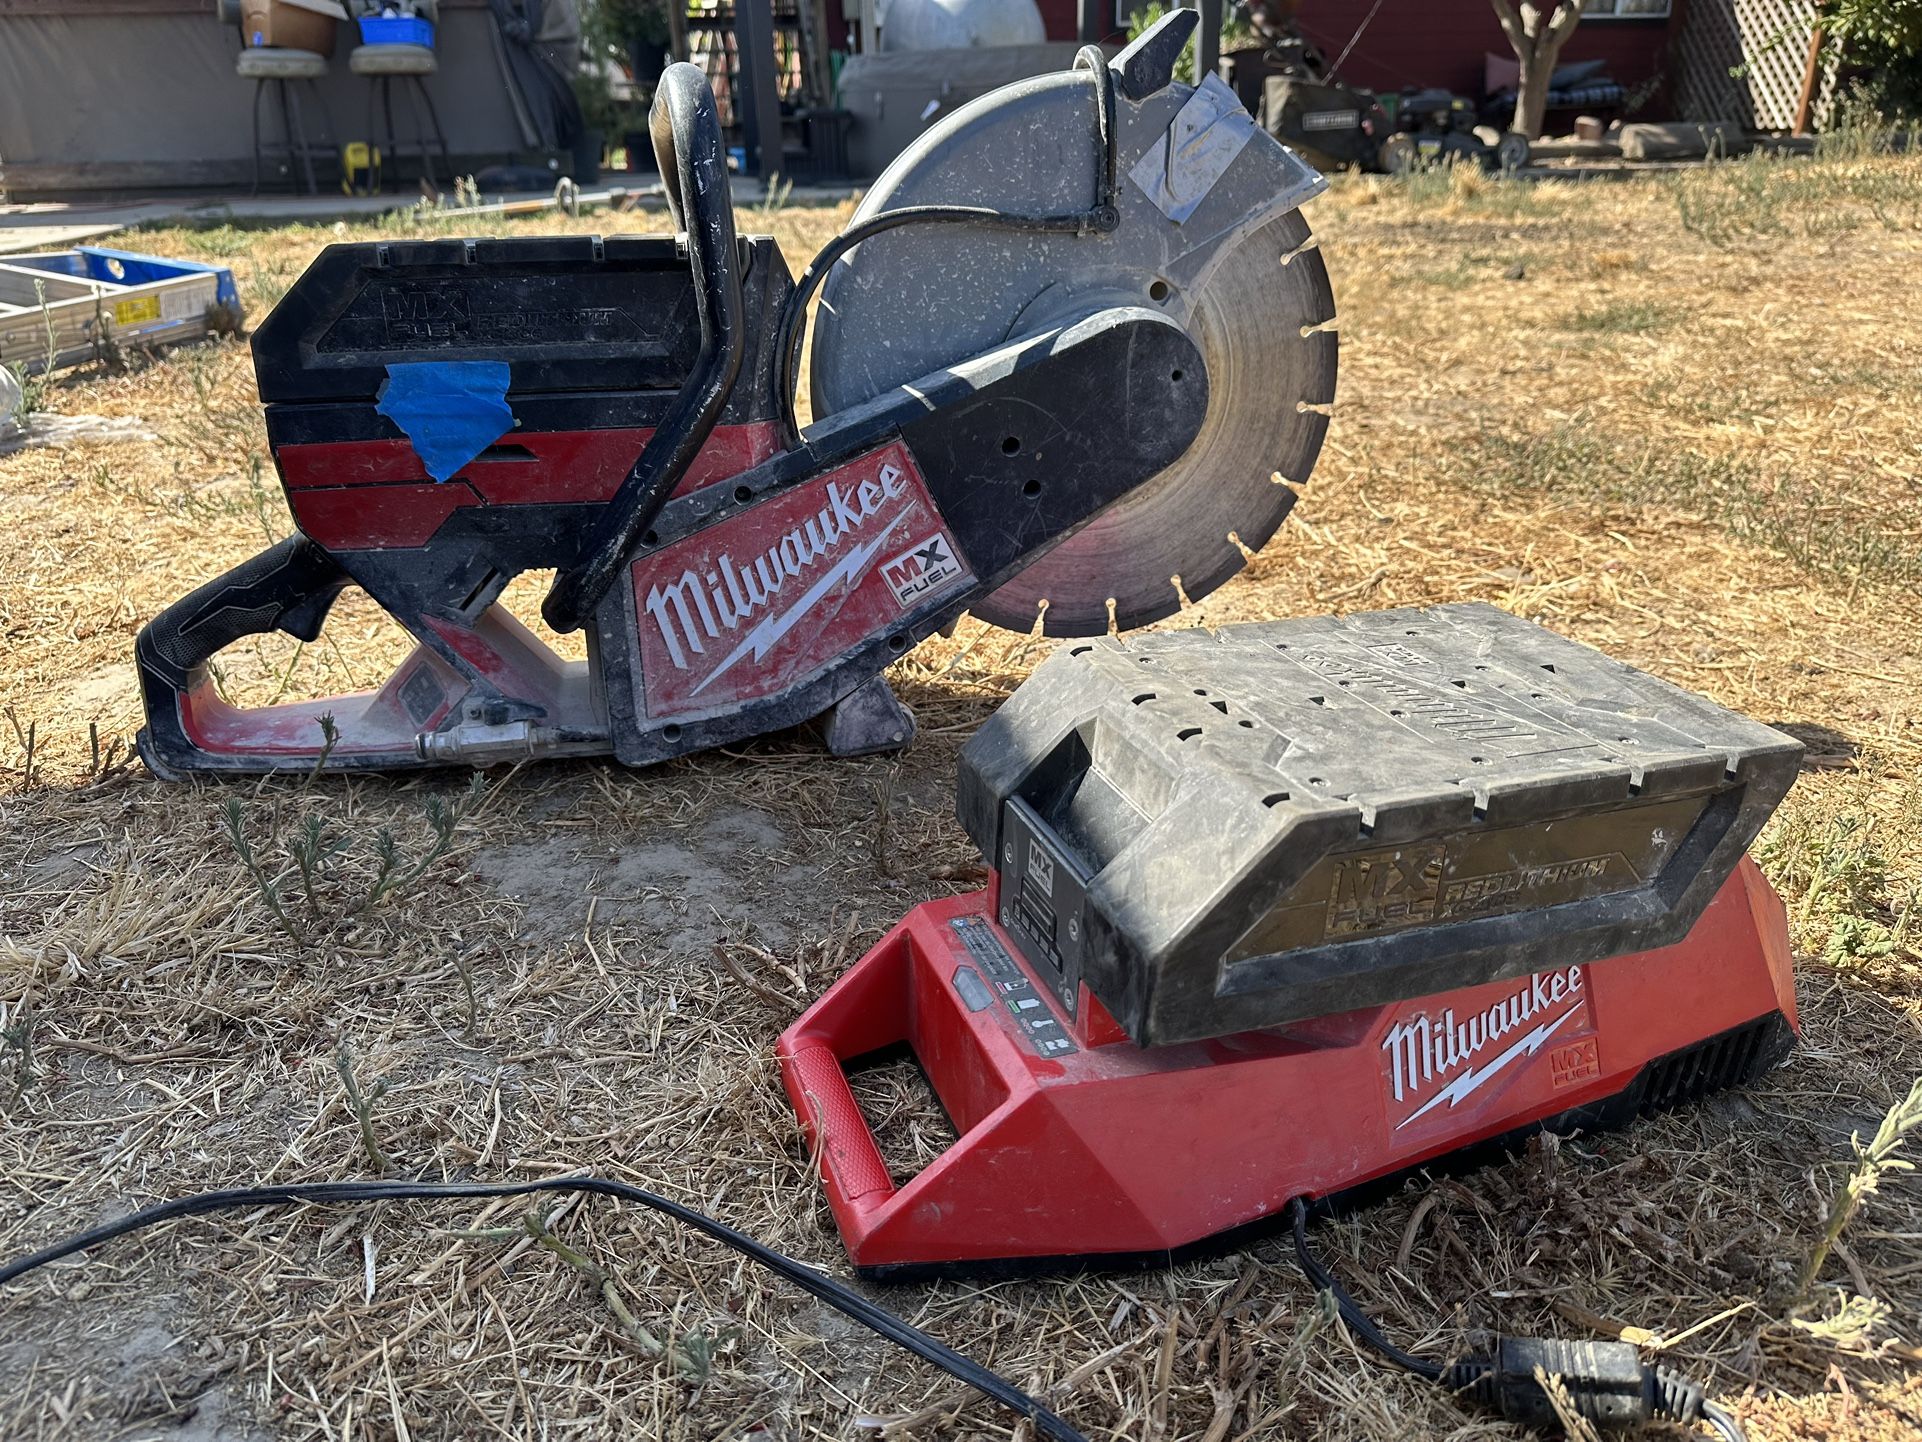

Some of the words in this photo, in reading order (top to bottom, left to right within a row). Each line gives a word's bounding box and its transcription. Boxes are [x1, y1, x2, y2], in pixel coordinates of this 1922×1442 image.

[646, 464, 907, 670] Milwaukee
[886, 538, 949, 589] MX
[900, 565, 957, 602] FUEL
[1030, 842, 1053, 876] MX
[1336, 855, 1437, 905] MX
[1444, 858, 1611, 903] REDLITHIUM
[1333, 901, 1428, 928] FUEL
[1382, 965, 1583, 1102] Milwaukee
[1551, 1043, 1595, 1072] MX
[1554, 1066, 1599, 1086] FUEL
